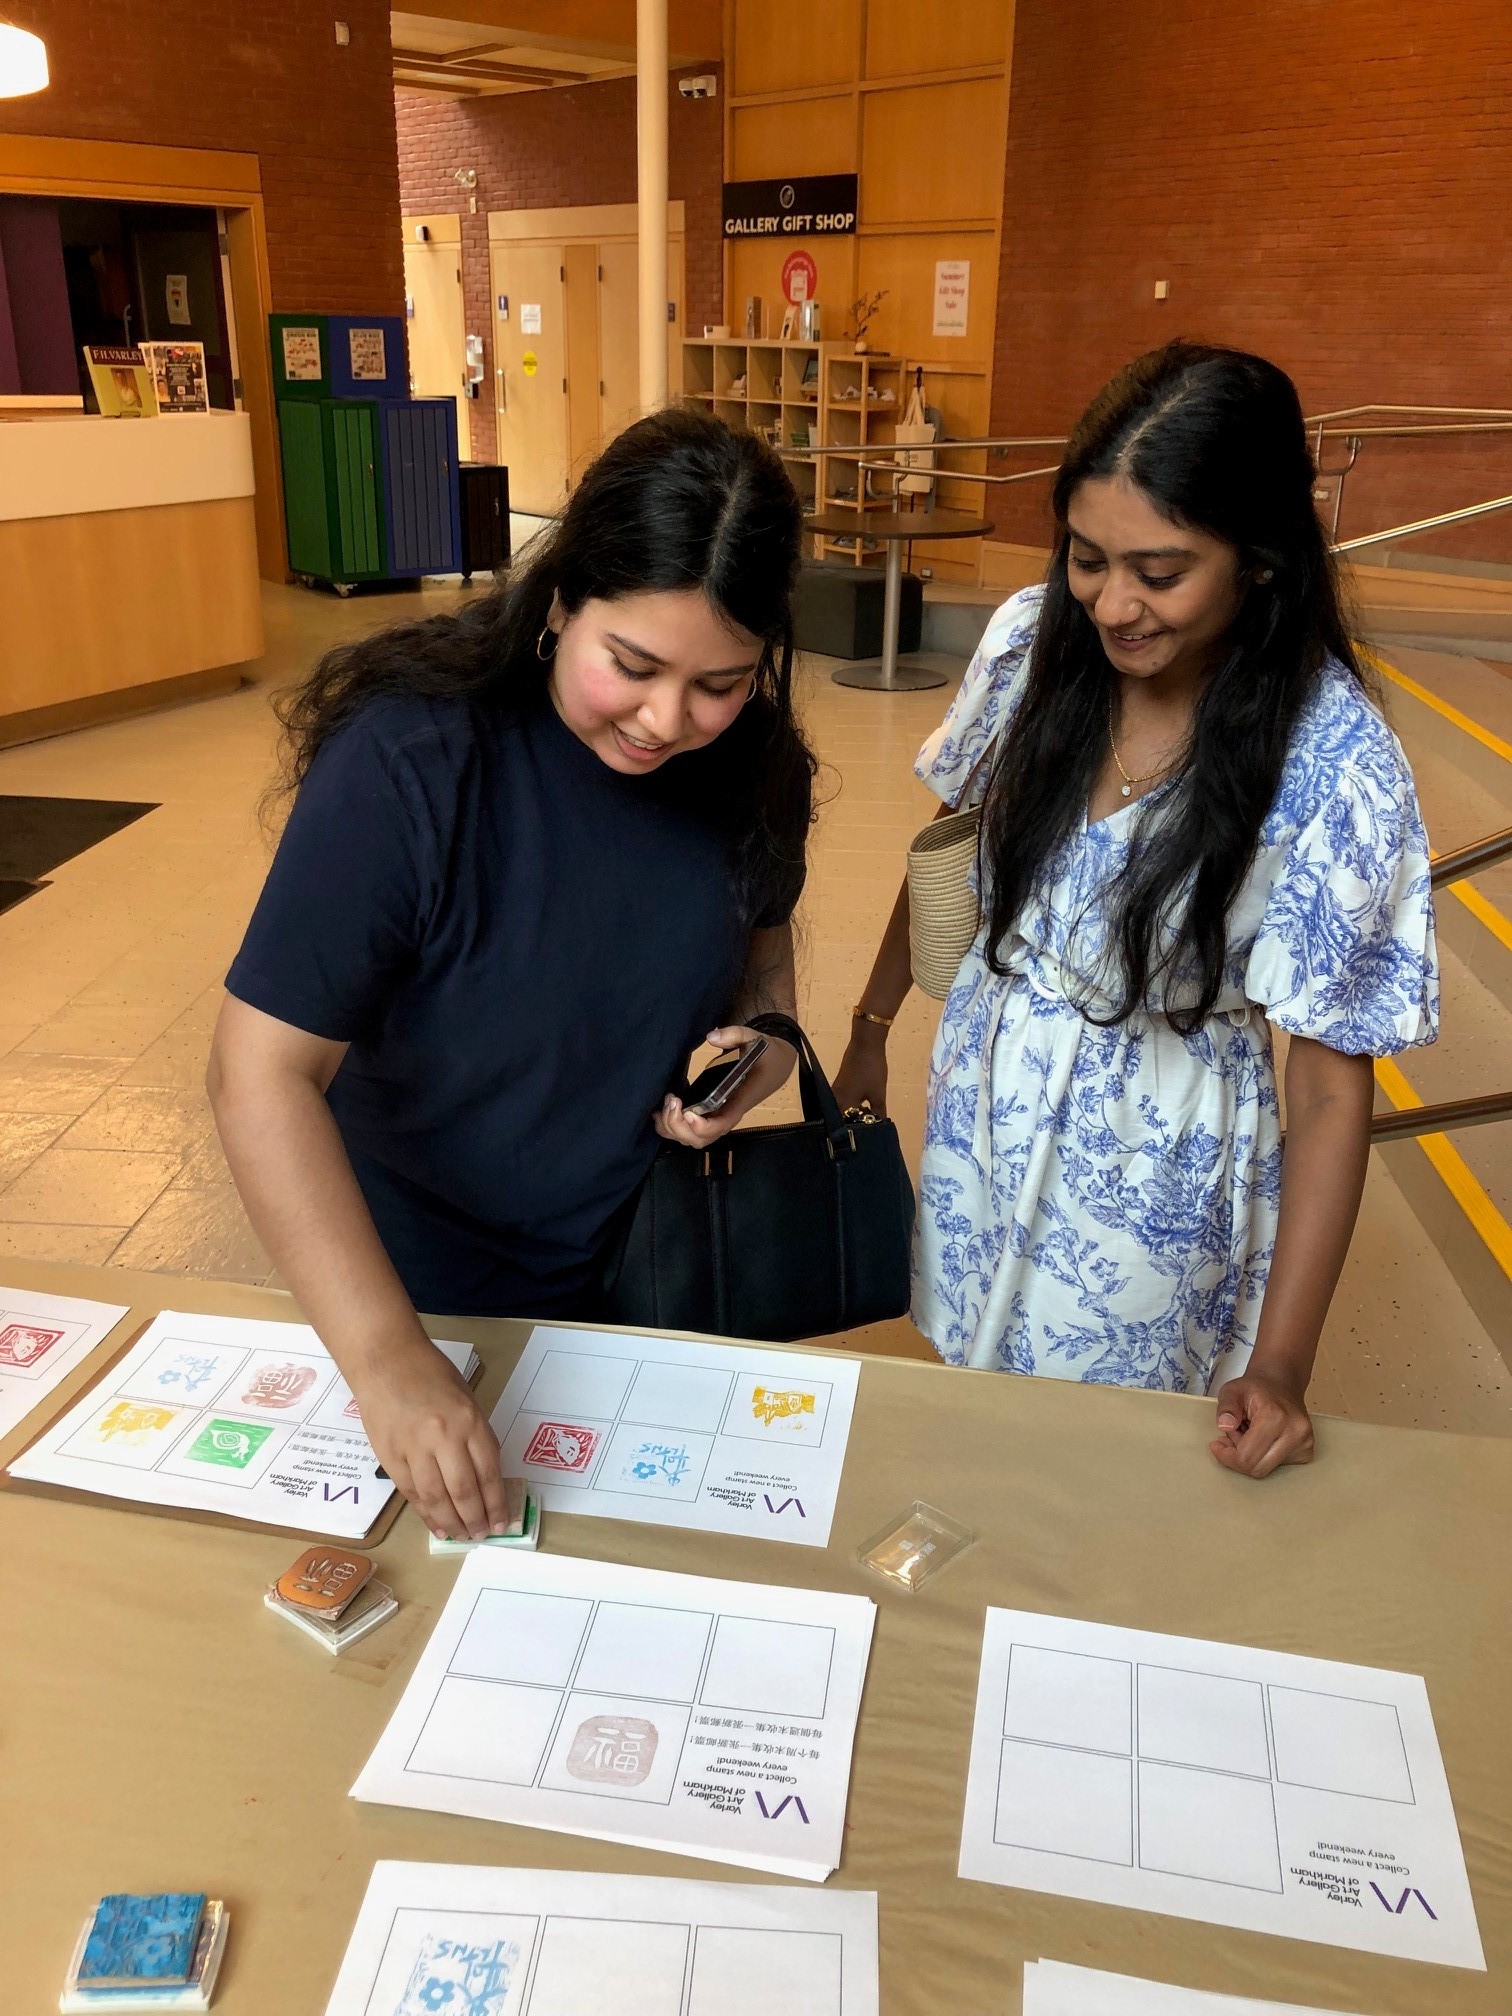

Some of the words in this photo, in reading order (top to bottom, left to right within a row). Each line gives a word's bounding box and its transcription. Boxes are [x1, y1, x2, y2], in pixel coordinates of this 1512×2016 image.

[725, 216, 780, 234] GALLERY
[782, 214, 813, 232] GIFT
[815, 212, 854, 230] SHOP
[292, 1464, 315, 1474] stamp
[302, 1459, 337, 1469] weekend!
[269, 1473, 308, 1485] Markham
[337, 1471, 362, 1480] Collect
[725, 1476, 748, 1484] stamp
[733, 1470, 769, 1480] weekend!
[269, 1479, 300, 1490] Gallery
[772, 1482, 798, 1491] Collect
[283, 1488, 308, 1498] Varley
[706, 1486, 746, 1497] Markham
[709, 1492, 740, 1502] Gallery
[726, 1501, 753, 1510] Varley
[716, 1757, 761, 1769] weekend!
[762, 1762, 788, 1772] every
[706, 1765, 735, 1776] stamp
[736, 1770, 756, 1778] new
[766, 1773, 797, 1785] Collect
[683, 1781, 733, 1794] Markham
[734, 1788, 746, 1796] of
[687, 1789, 726, 1803] Gallery
[727, 1796, 745, 1805] Art
[709, 1802, 742, 1815] Varley
[1317, 1841, 1366, 1856] weekend!
[1309, 1850, 1340, 1863] stamp
[1368, 1849, 1396, 1861] every
[1342, 1857, 1365, 1867] new
[1374, 1862, 1410, 1876] Collect
[1290, 1867, 1345, 1885] Markham
[1298, 1877, 1340, 1893] Gallery
[1348, 1878, 1360, 1886] of
[1342, 1886, 1361, 1896] Art
[1327, 1892, 1363, 1907] Varley
